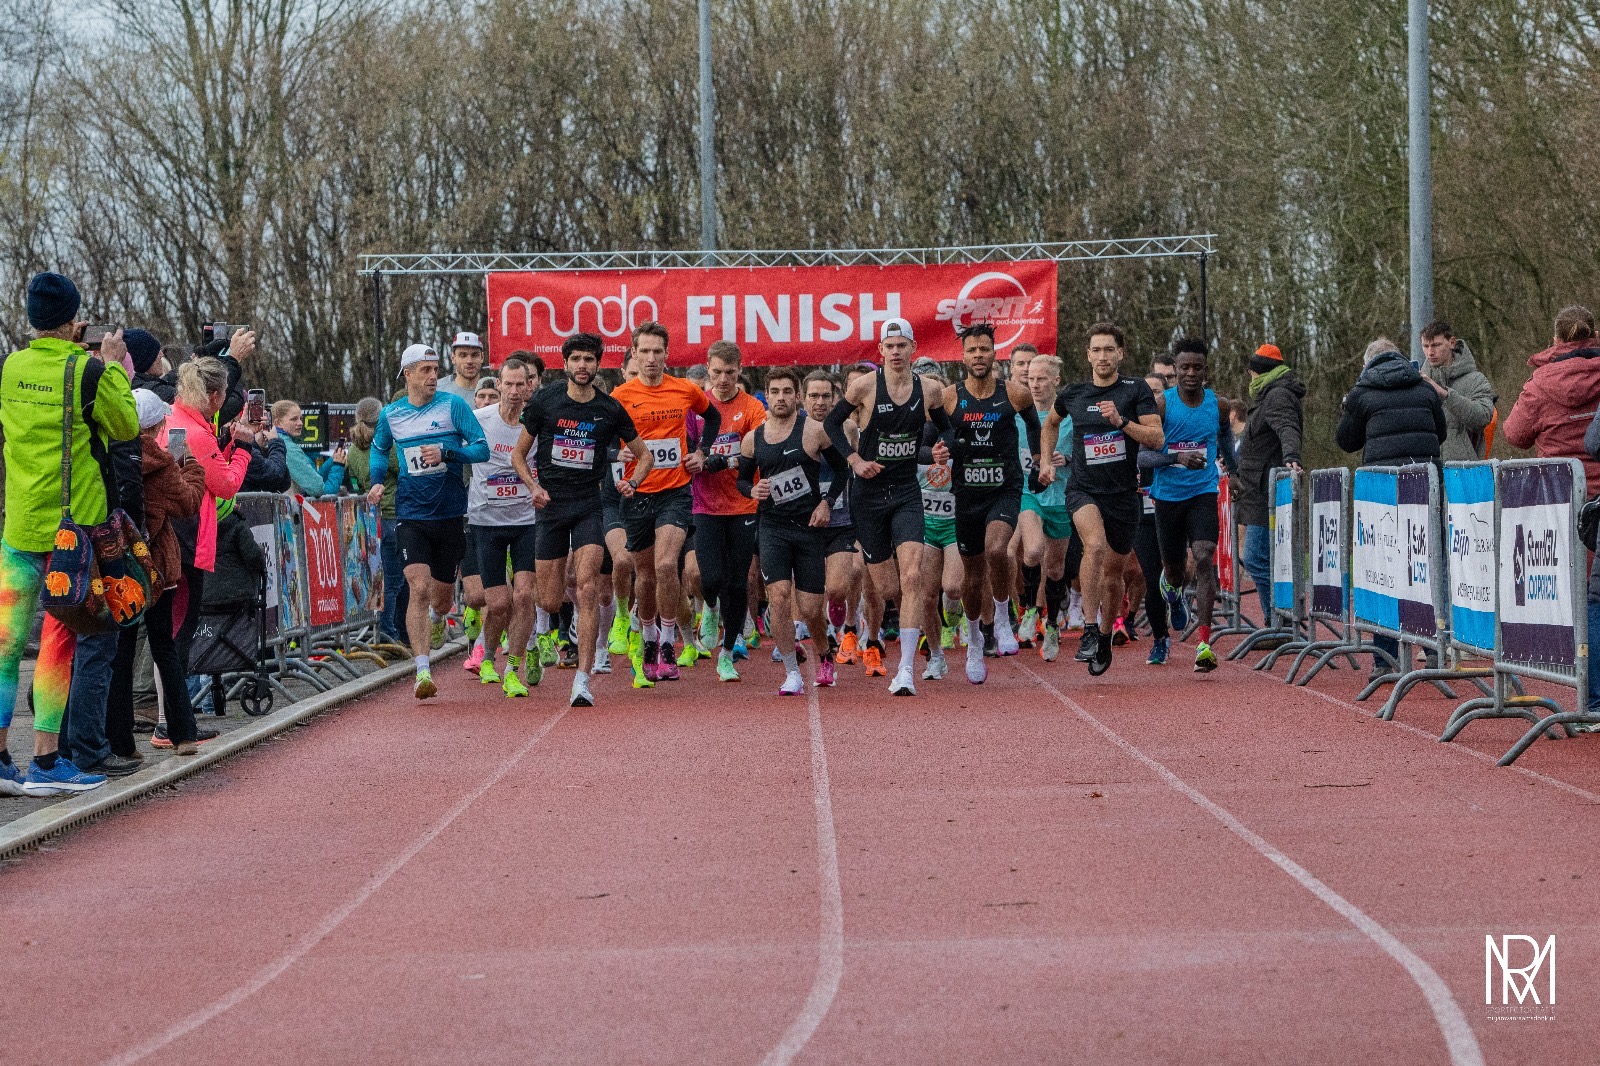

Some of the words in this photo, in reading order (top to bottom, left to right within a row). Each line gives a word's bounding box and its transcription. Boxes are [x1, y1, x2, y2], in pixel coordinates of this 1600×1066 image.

[502, 284, 658, 337] mundo
[935, 296, 1032, 320] SPIRIT
[687, 293, 900, 343] FINISH
[17, 380, 53, 393] Anton
[303, 415, 319, 442] 5
[561, 448, 585, 461] 991
[711, 444, 732, 456] 747
[878, 440, 917, 457] 66005
[1093, 443, 1117, 457] 966
[410, 456, 441, 470] 18
[964, 467, 1004, 483] 66013
[496, 485, 518, 497] 850
[773, 476, 804, 498] 148
[923, 498, 952, 513] 276
